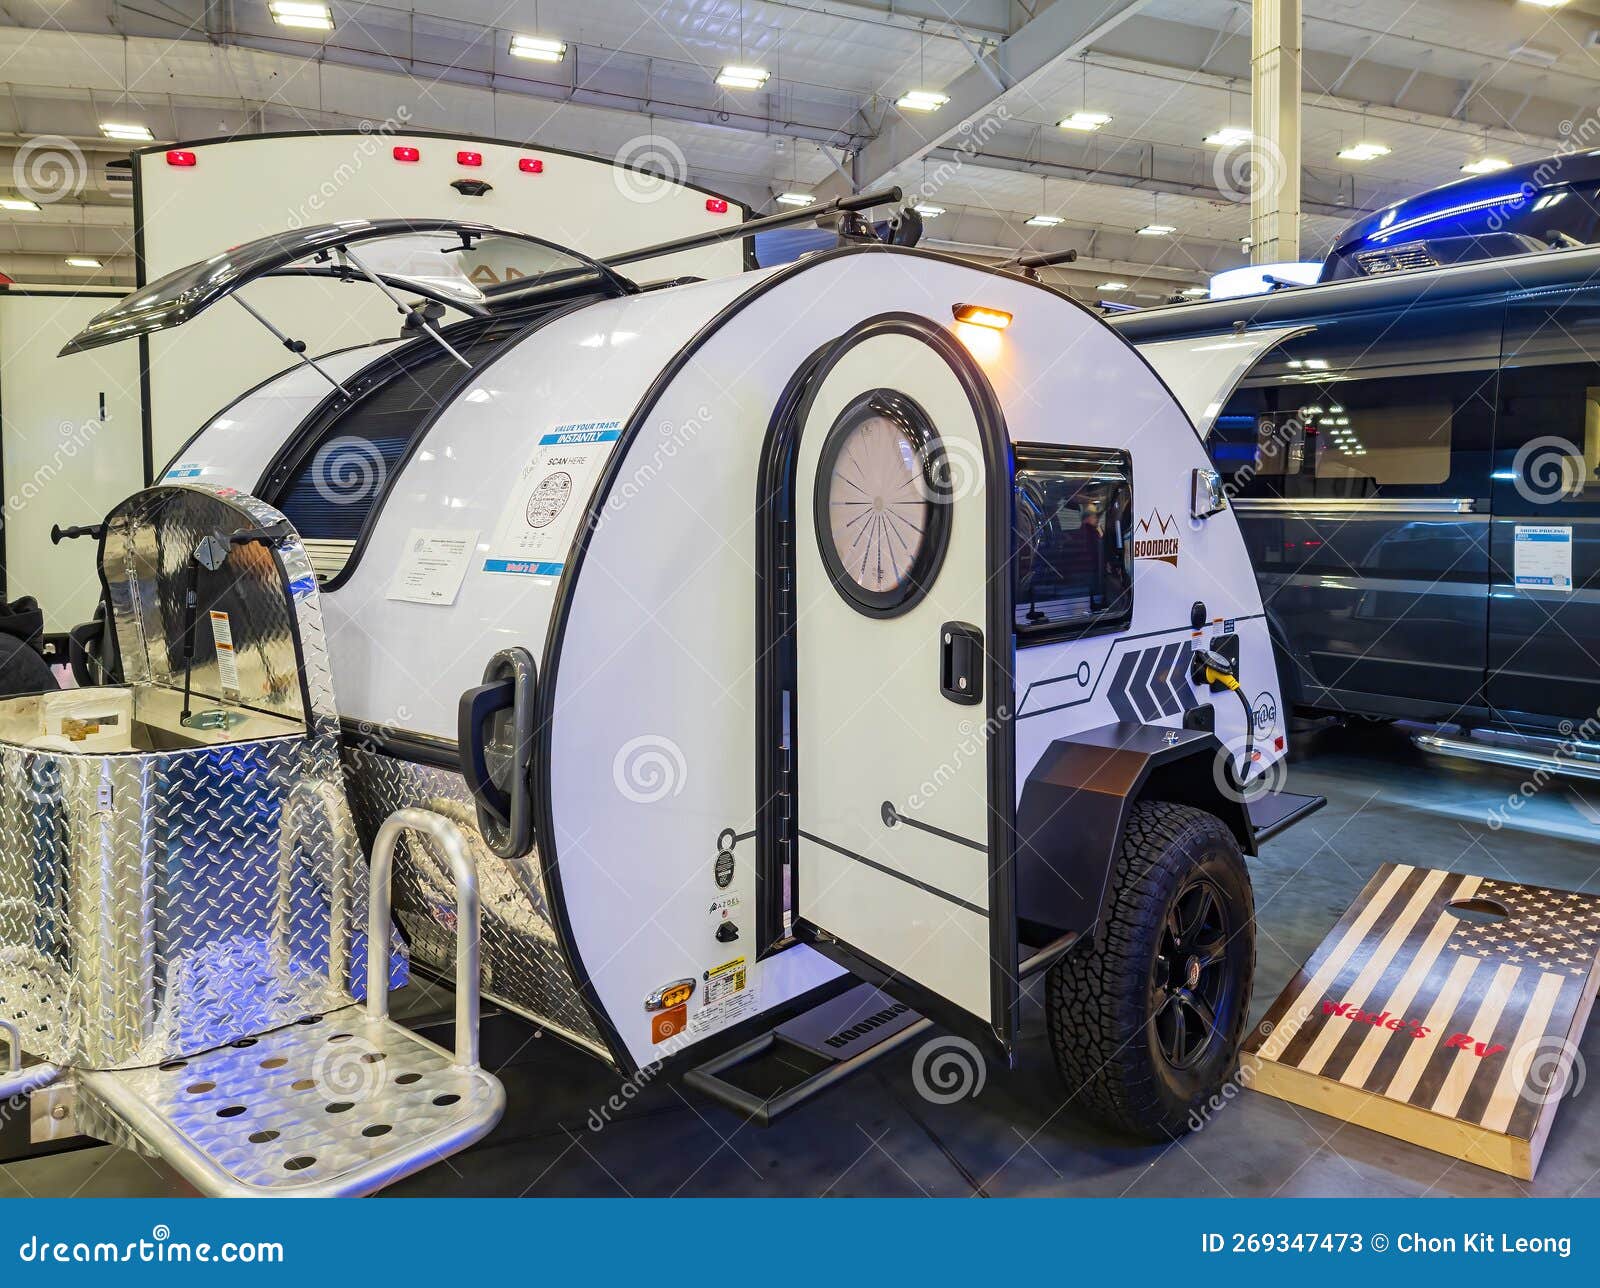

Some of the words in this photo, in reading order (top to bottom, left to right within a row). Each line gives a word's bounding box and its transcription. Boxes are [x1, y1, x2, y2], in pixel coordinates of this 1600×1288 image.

[554, 424, 577, 433] VALUE
[577, 423, 595, 431] YOUR
[596, 421, 620, 430] TRADE
[557, 432, 603, 444] INSTANTLY
[547, 457, 569, 466] SCAN
[569, 456, 588, 465] HERE
[1134, 538, 1179, 557] BOONDOCK
[1321, 1000, 1431, 1039] Wade's
[1444, 1032, 1505, 1057] RV
